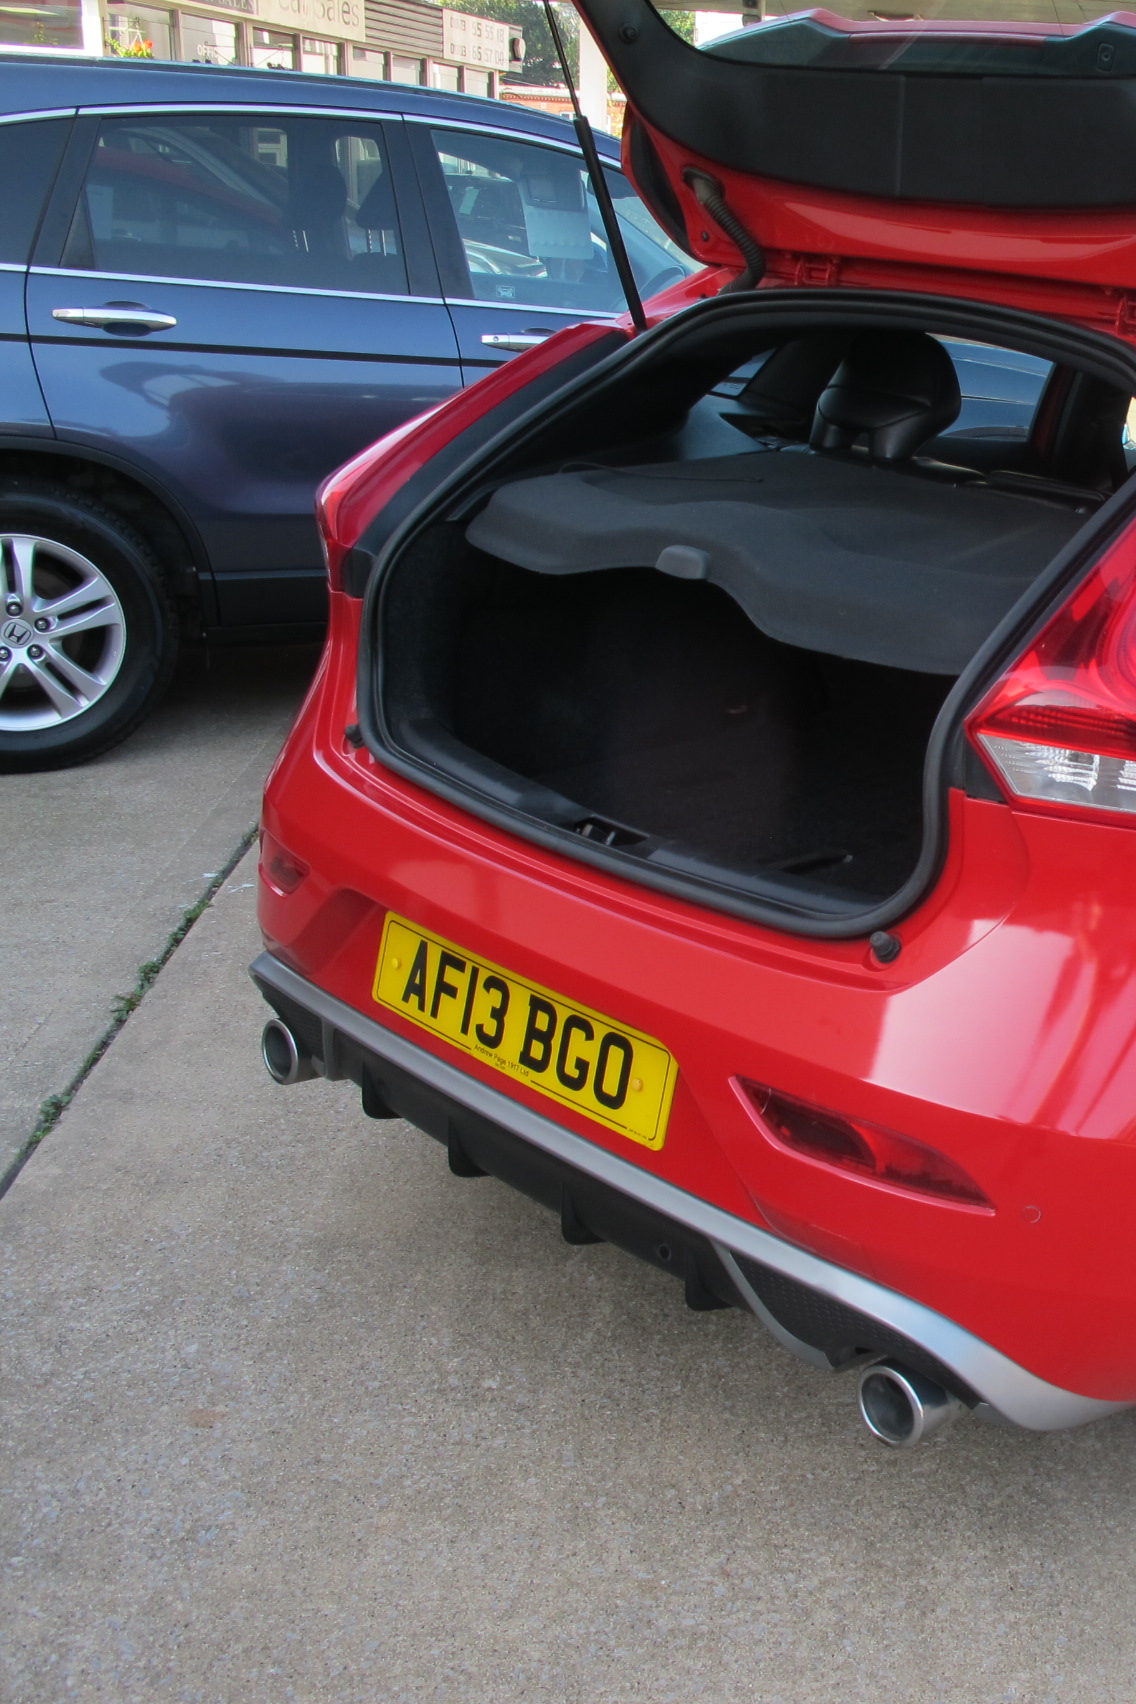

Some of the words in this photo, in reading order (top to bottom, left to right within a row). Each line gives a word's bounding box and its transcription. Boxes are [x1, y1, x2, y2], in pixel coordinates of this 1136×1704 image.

[401, 939, 511, 1050] AF13
[518, 993, 634, 1110] BGO
[475, 1044, 493, 1057] Andrew
[493, 1053, 507, 1066] Page
[520, 1067, 530, 1077] Ltd
